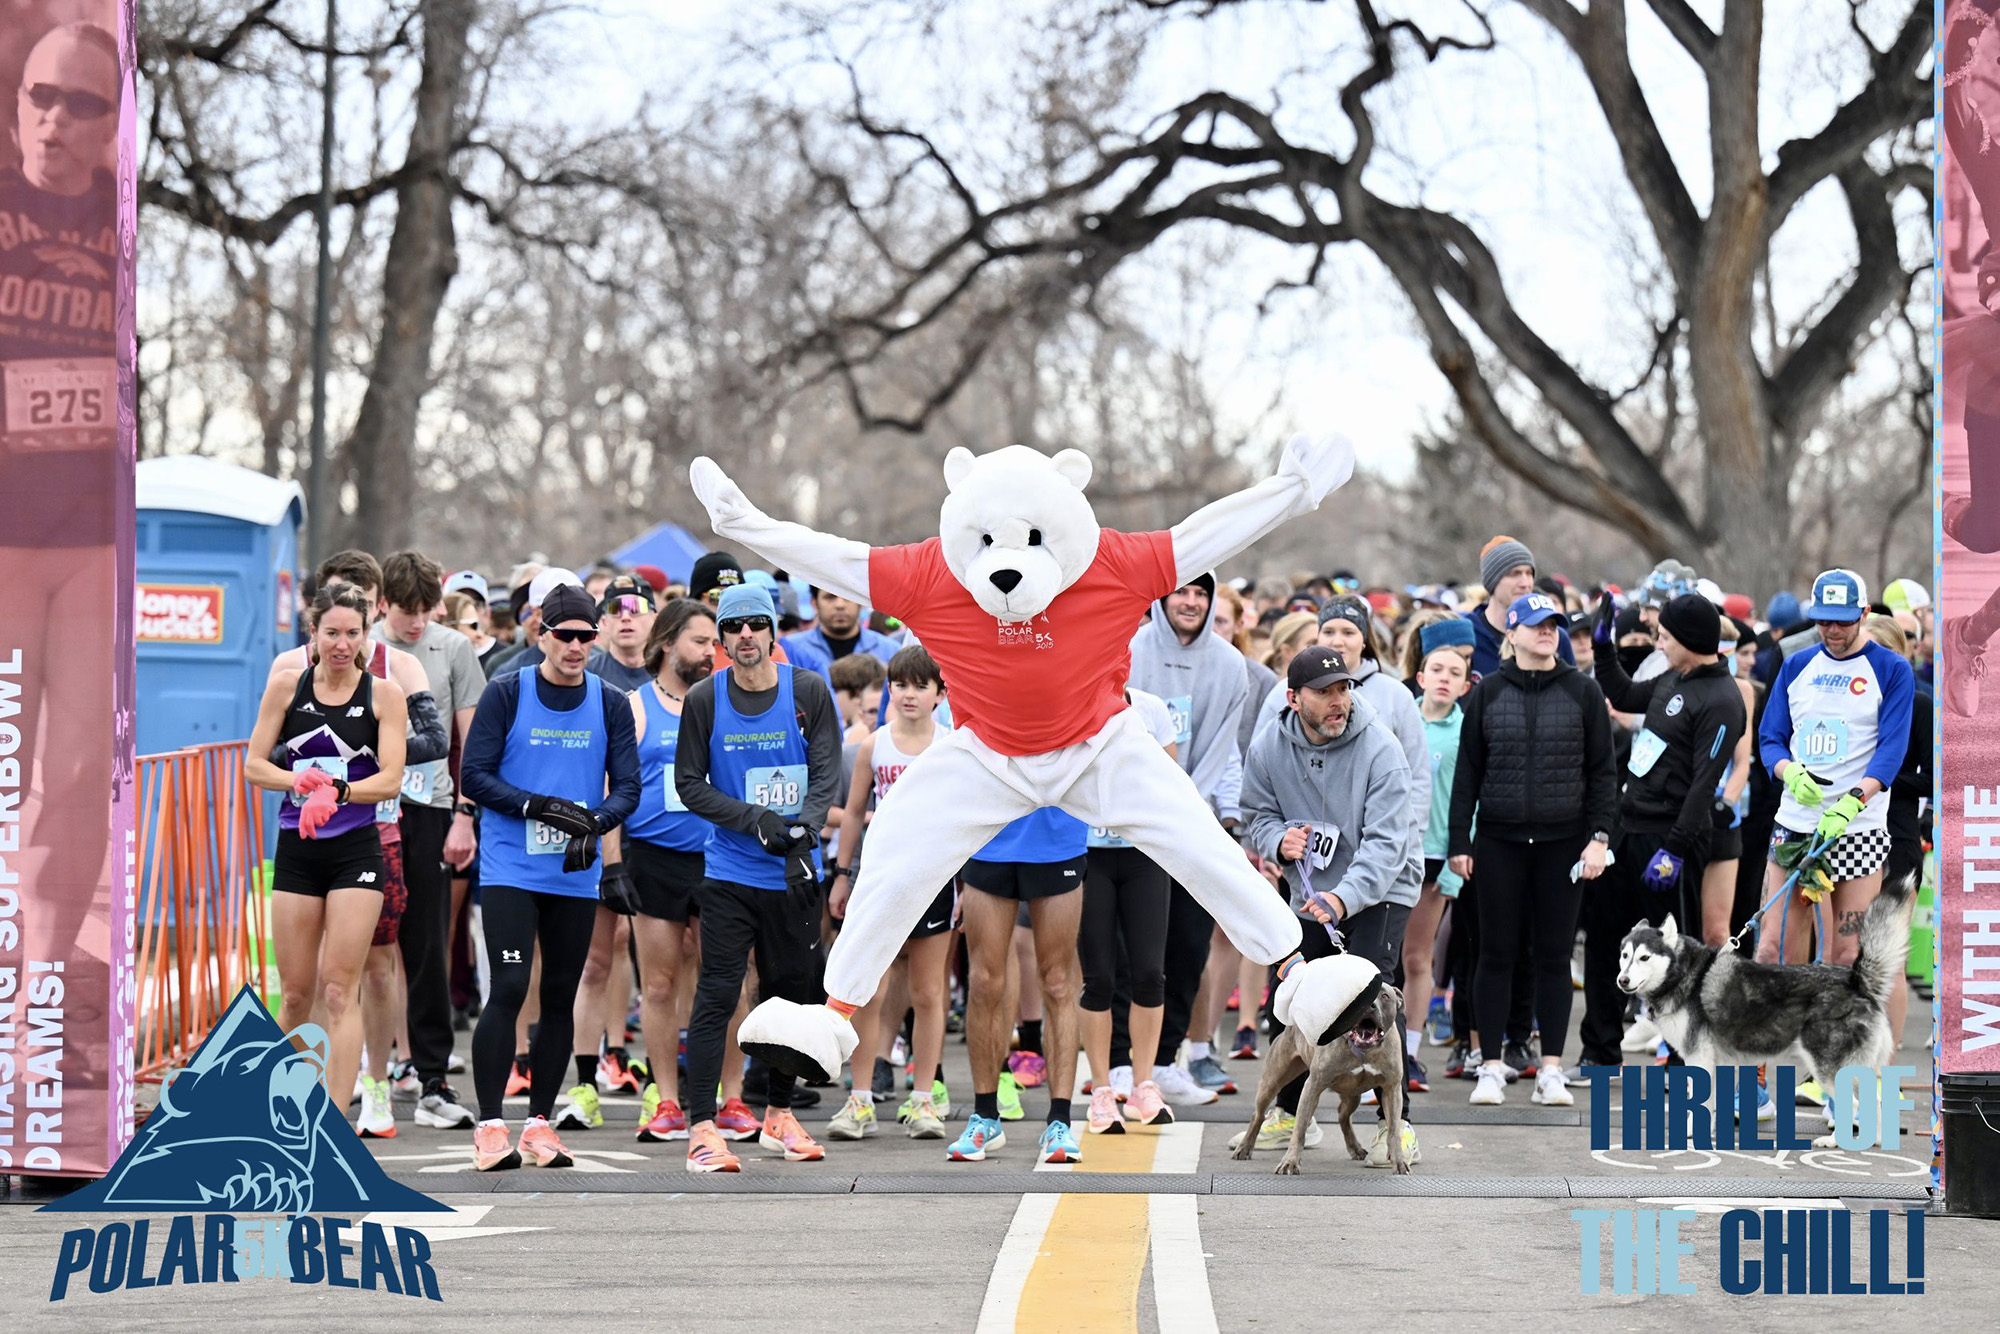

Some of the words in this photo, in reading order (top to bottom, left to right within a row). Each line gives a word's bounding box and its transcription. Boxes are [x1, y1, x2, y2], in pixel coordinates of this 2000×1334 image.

[0, 275, 116, 332] OOTBA
[30, 388, 102, 425] 275
[136, 612, 218, 640] ucket
[998, 627, 1033, 636] POLAR
[998, 635, 1034, 645] BEAR
[531, 728, 592, 739] ENDURANCE
[562, 739, 590, 748] TEAM
[724, 731, 787, 743] ENDURANCE
[757, 741, 785, 751] TEAM
[1804, 733, 1838, 757] 106
[755, 782, 799, 807] 548
[535, 819, 572, 845] 55
[1963, 785, 2000, 892] THE
[1962, 910, 2000, 1053] WITH
[24, 960, 65, 1171] DREAMS!
